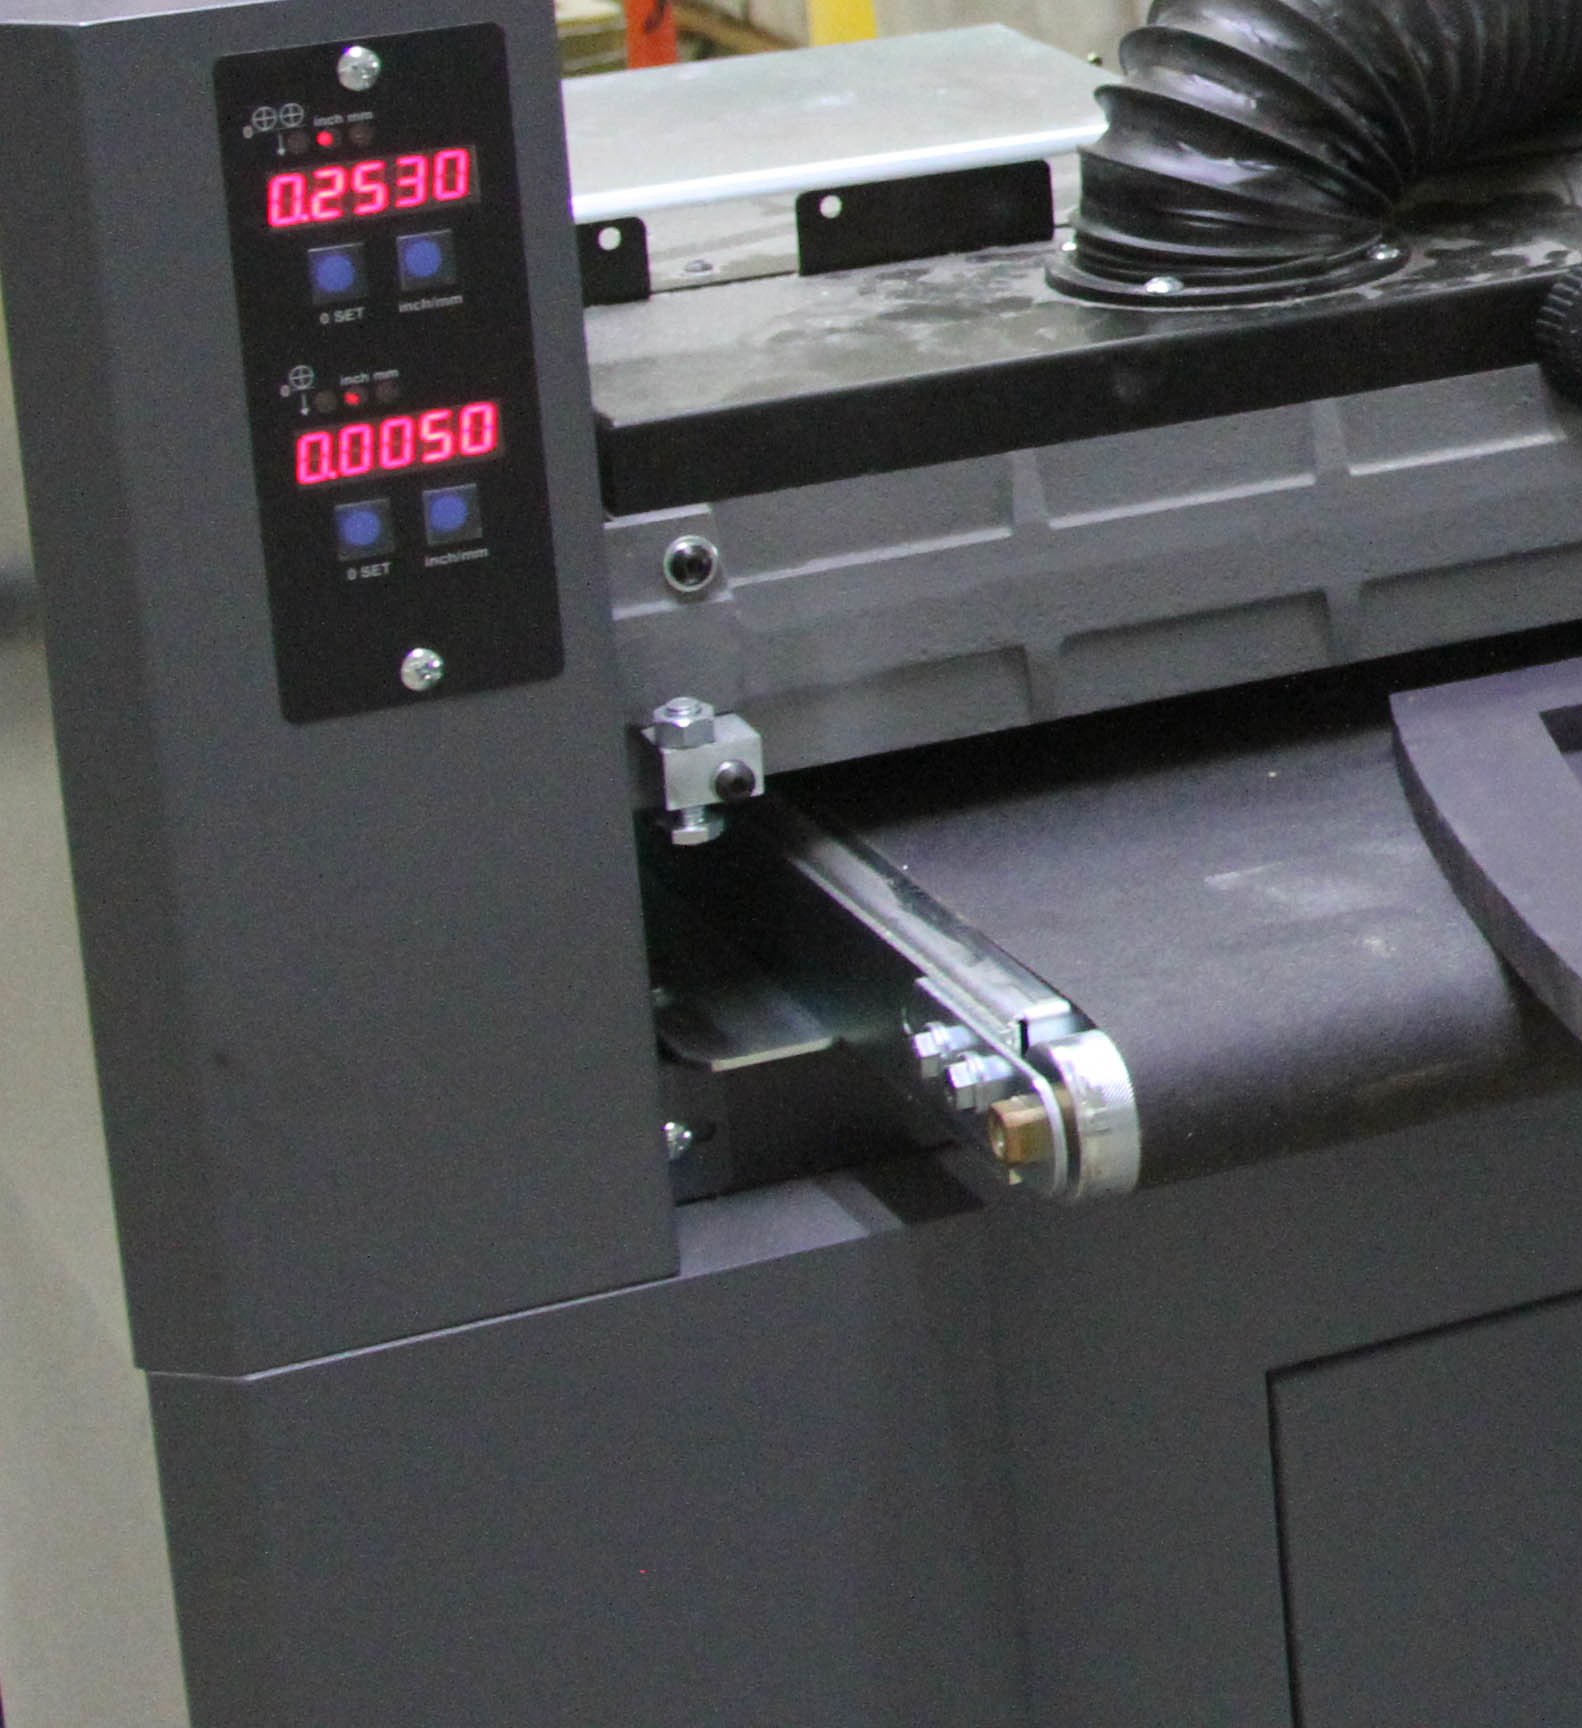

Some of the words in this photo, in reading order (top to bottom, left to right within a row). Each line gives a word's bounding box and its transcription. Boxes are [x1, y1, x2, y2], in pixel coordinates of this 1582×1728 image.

[313, 114, 344, 127] inch
[347, 110, 374, 122] mm
[267, 148, 470, 228] 0.2530
[399, 295, 464, 313] inch/mm
[333, 307, 366, 323] SET
[340, 373, 370, 387] inch
[373, 369, 400, 381] mm
[296, 401, 499, 485] 0.0050
[424, 548, 489, 568] inch/mm
[360, 562, 392, 578] SET
